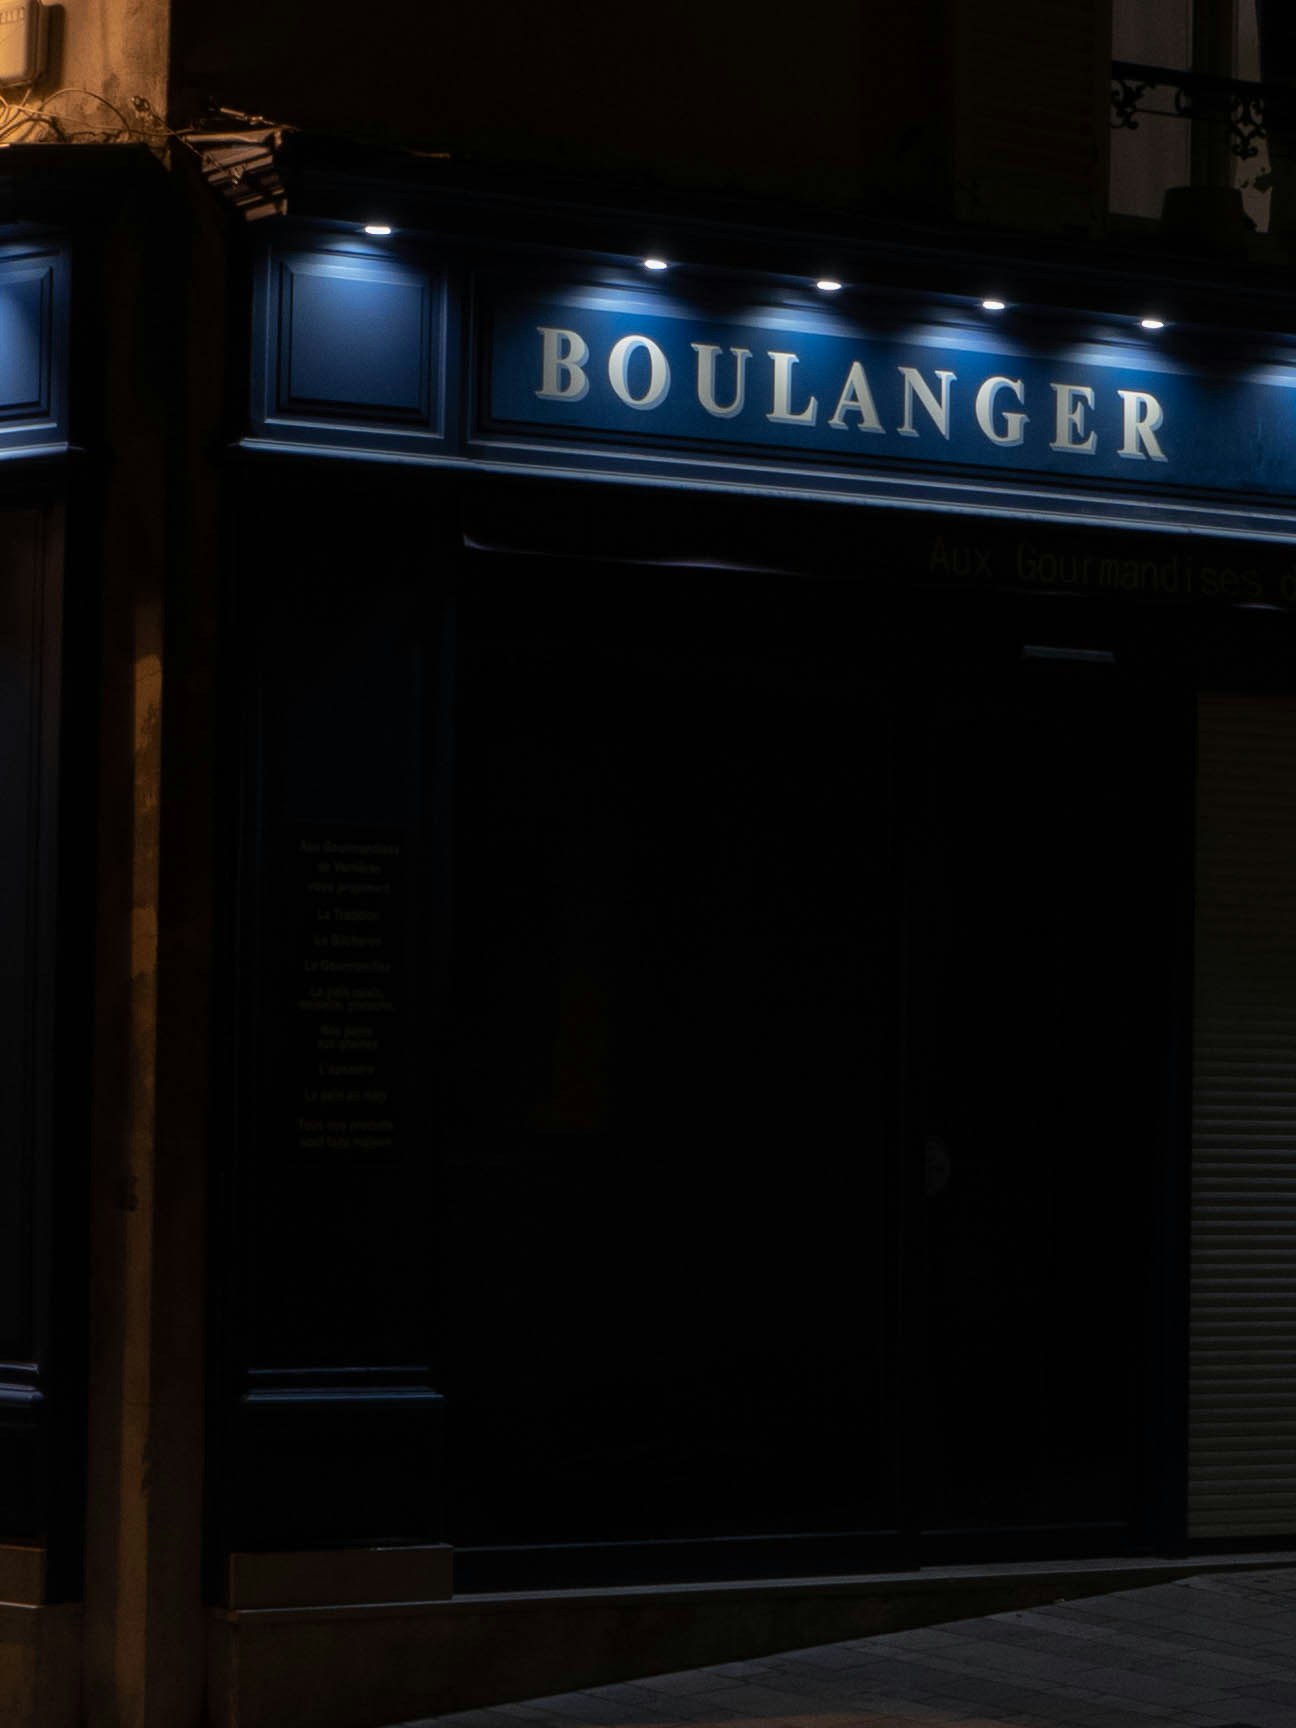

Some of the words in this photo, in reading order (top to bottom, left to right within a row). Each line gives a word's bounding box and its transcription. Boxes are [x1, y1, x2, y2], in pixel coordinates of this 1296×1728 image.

[535, 326, 1169, 463] BOULANGER
[929, 535, 993, 577] Aux
[1015, 540, 1264, 598] Gourmandises
